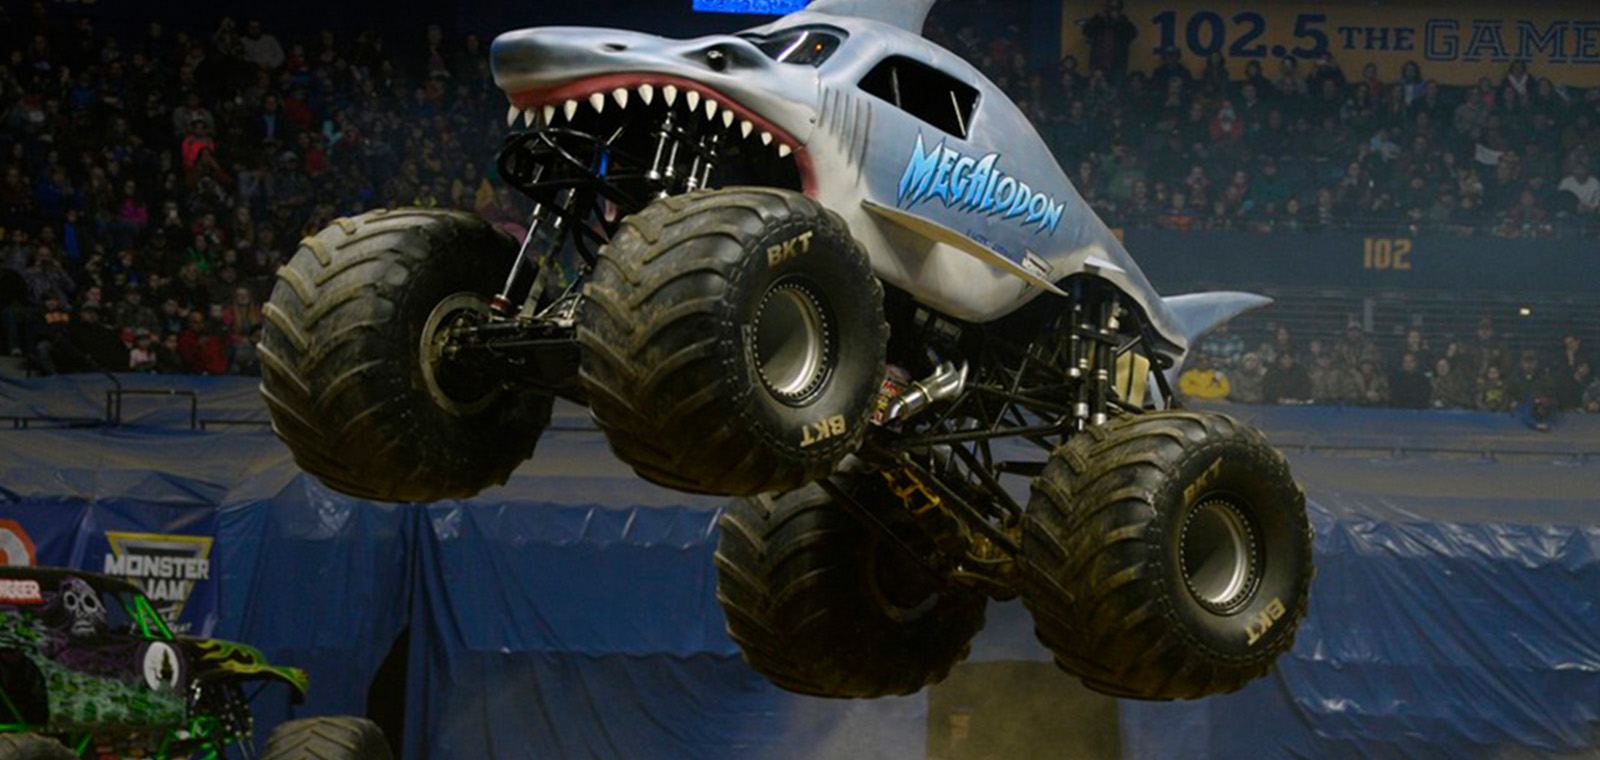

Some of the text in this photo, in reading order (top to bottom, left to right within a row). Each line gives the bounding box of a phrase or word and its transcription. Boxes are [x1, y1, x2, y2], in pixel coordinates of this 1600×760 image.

[1150, 10, 1600, 64] 102.5 THE GAME
[897, 128, 1066, 235] MEGALODON
[767, 230, 814, 267] BKT
[1364, 238, 1412, 270] 102
[800, 413, 847, 447] BKT
[104, 553, 209, 579] MONSTER
[147, 579, 186, 600] JAM
[1244, 597, 1287, 646] BKT
